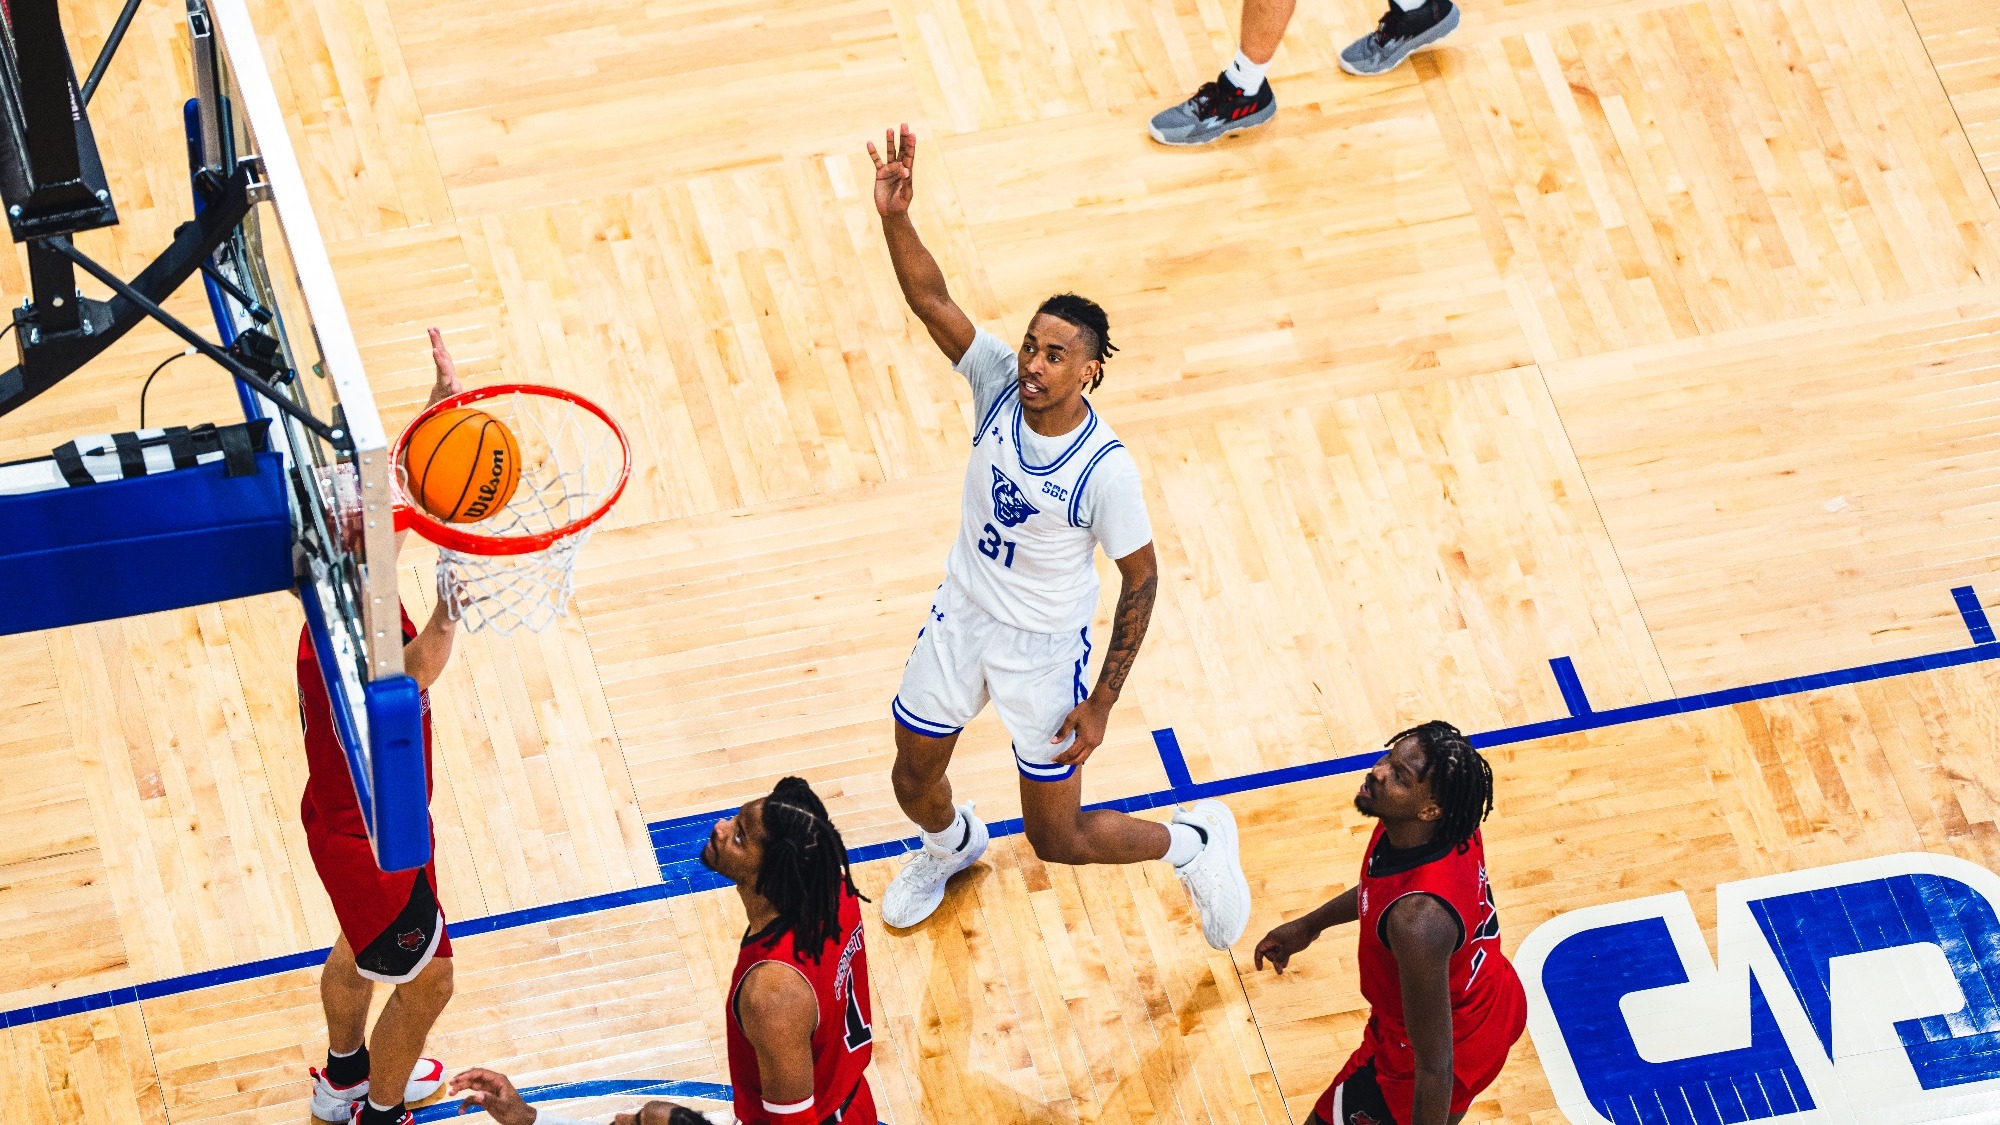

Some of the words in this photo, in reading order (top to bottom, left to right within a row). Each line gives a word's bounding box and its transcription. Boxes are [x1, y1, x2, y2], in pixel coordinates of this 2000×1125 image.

[463, 449, 504, 517] Wilson
[1041, 480, 1068, 502] SBC
[978, 522, 1016, 568] 31
